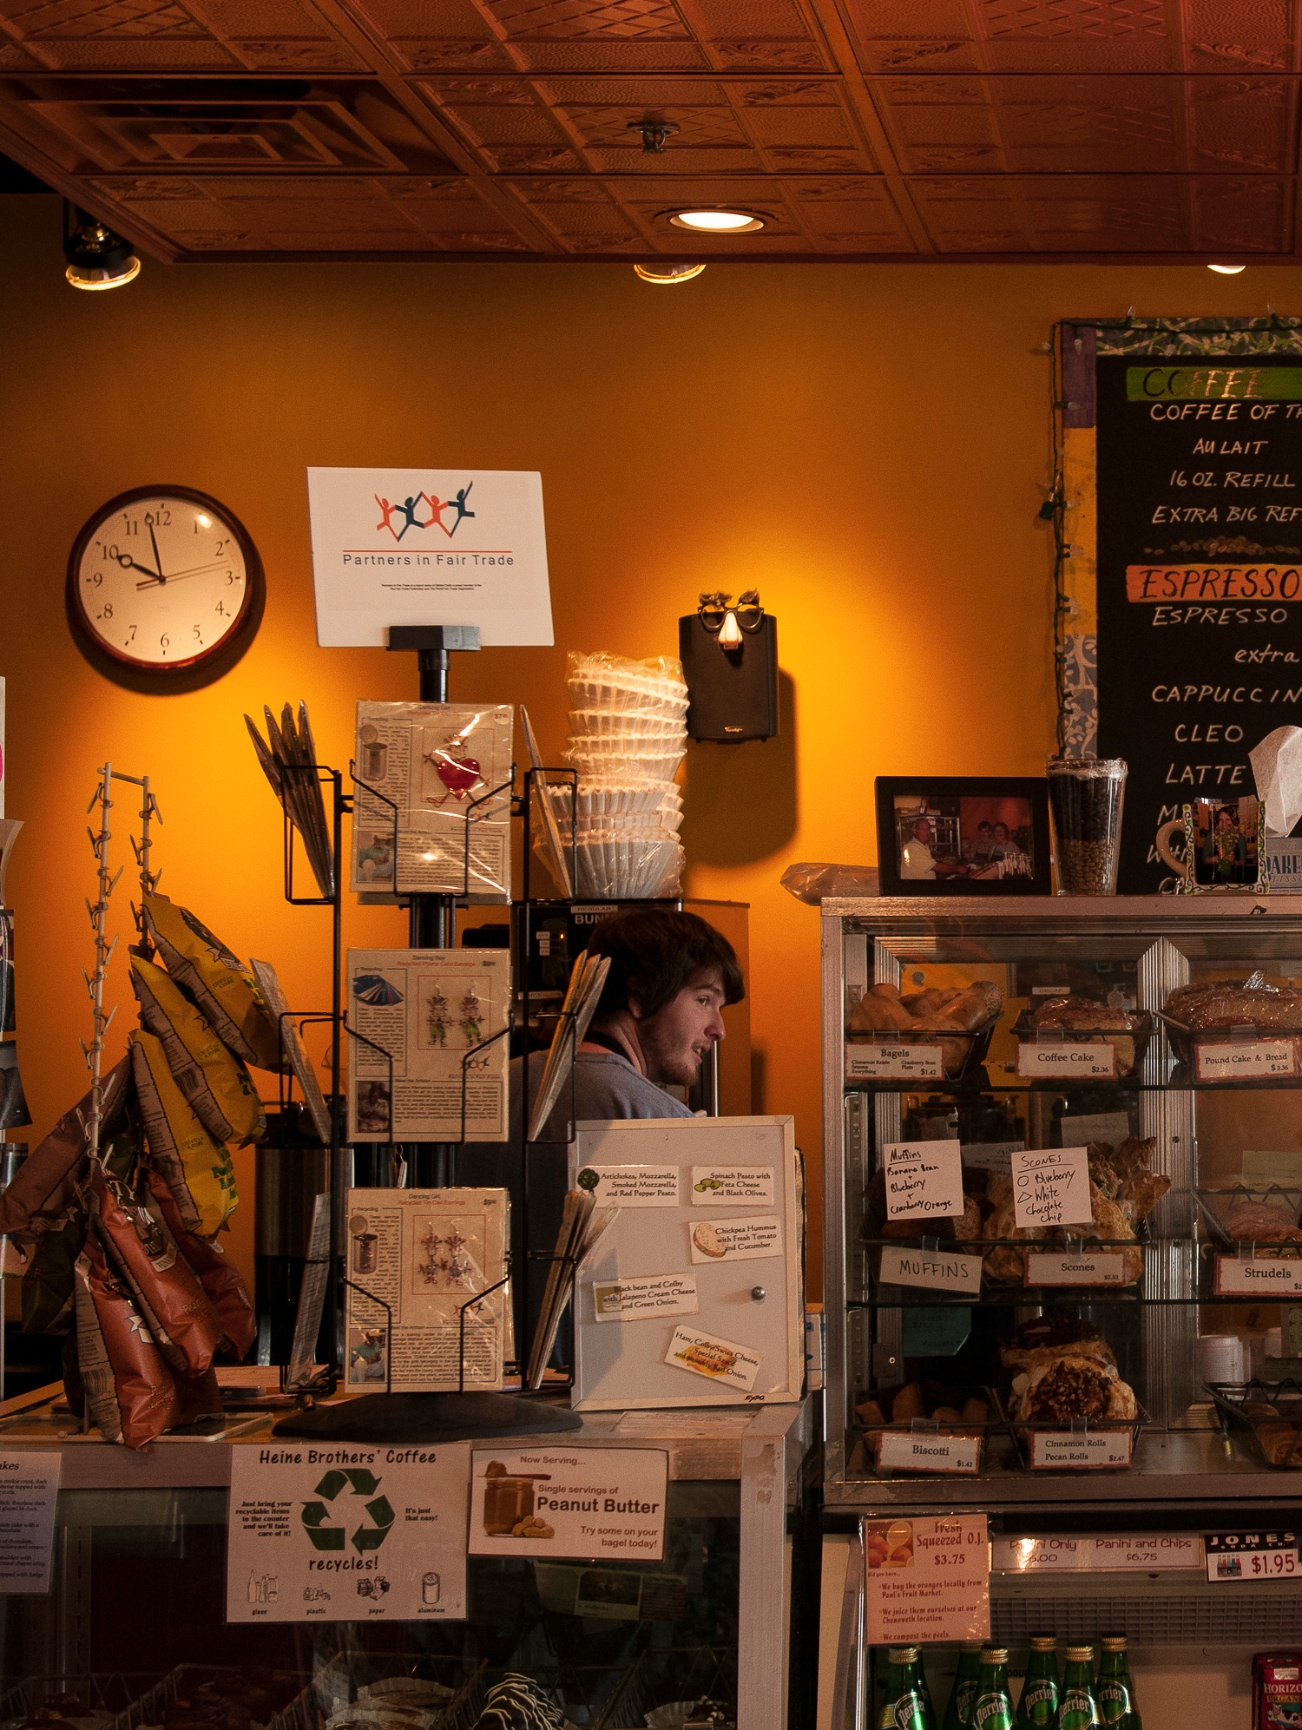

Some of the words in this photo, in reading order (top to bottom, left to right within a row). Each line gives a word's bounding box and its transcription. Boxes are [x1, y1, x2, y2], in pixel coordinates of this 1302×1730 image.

[1142, 368, 1263, 397] COFFEE
[1150, 403, 1239, 420] COFFEE
[1251, 405, 1276, 419] OF
[1193, 440, 1217, 454] AU
[1221, 441, 1268, 454] LAIT
[156, 511, 171, 527] 12
[126, 521, 139, 536] 11
[215, 541, 225, 556] 2
[343, 555, 411, 566] Partners
[417, 555, 430, 565] in
[437, 555, 466, 566] Fair
[472, 555, 514, 566] Trade
[93, 573, 103, 587] 9
[225, 571, 234, 585] 3
[1140, 569, 1300, 599] ESPRESSO
[103, 604, 114, 618] 8
[214, 601, 224, 615] 4
[1152, 606, 1288, 625] ESPRESSO
[129, 625, 137, 640] 7
[192, 625, 200, 639] 5
[160, 632, 169, 647] 6
[881, 1049, 910, 1060] Bagels
[1038, 1053, 1065, 1063] Coffee
[1067, 1053, 1094, 1062] Cake
[1205, 1056, 1228, 1064] Pound
[1230, 1055, 1251, 1064] Cake
[1266, 1053, 1288, 1062] Bread
[710, 1172, 735, 1180] Spinach
[900, 1260, 968, 1278] MUFFINS
[1061, 1263, 1095, 1271] Scones
[1245, 1267, 1291, 1278] Strudels
[1087, 1439, 1106, 1447] Rolls
[260, 1450, 302, 1464] Heine
[308, 1450, 381, 1463] Brothers'
[387, 1450, 436, 1463] Coffee
[913, 1445, 949, 1456] Biscotti
[1069, 1452, 1088, 1460] Rolls
[543, 1456, 585, 1465] Serving...
[538, 1497, 599, 1512] Peanut
[605, 1499, 659, 1513] Butter
[917, 1533, 962, 1549] Squeezed
[968, 1532, 984, 1546] O.J.
[1210, 1532, 1296, 1546] JONES
[310, 1556, 378, 1572] recycles!
[935, 1554, 965, 1566] $3.75
[1251, 1554, 1295, 1574] $1.95
